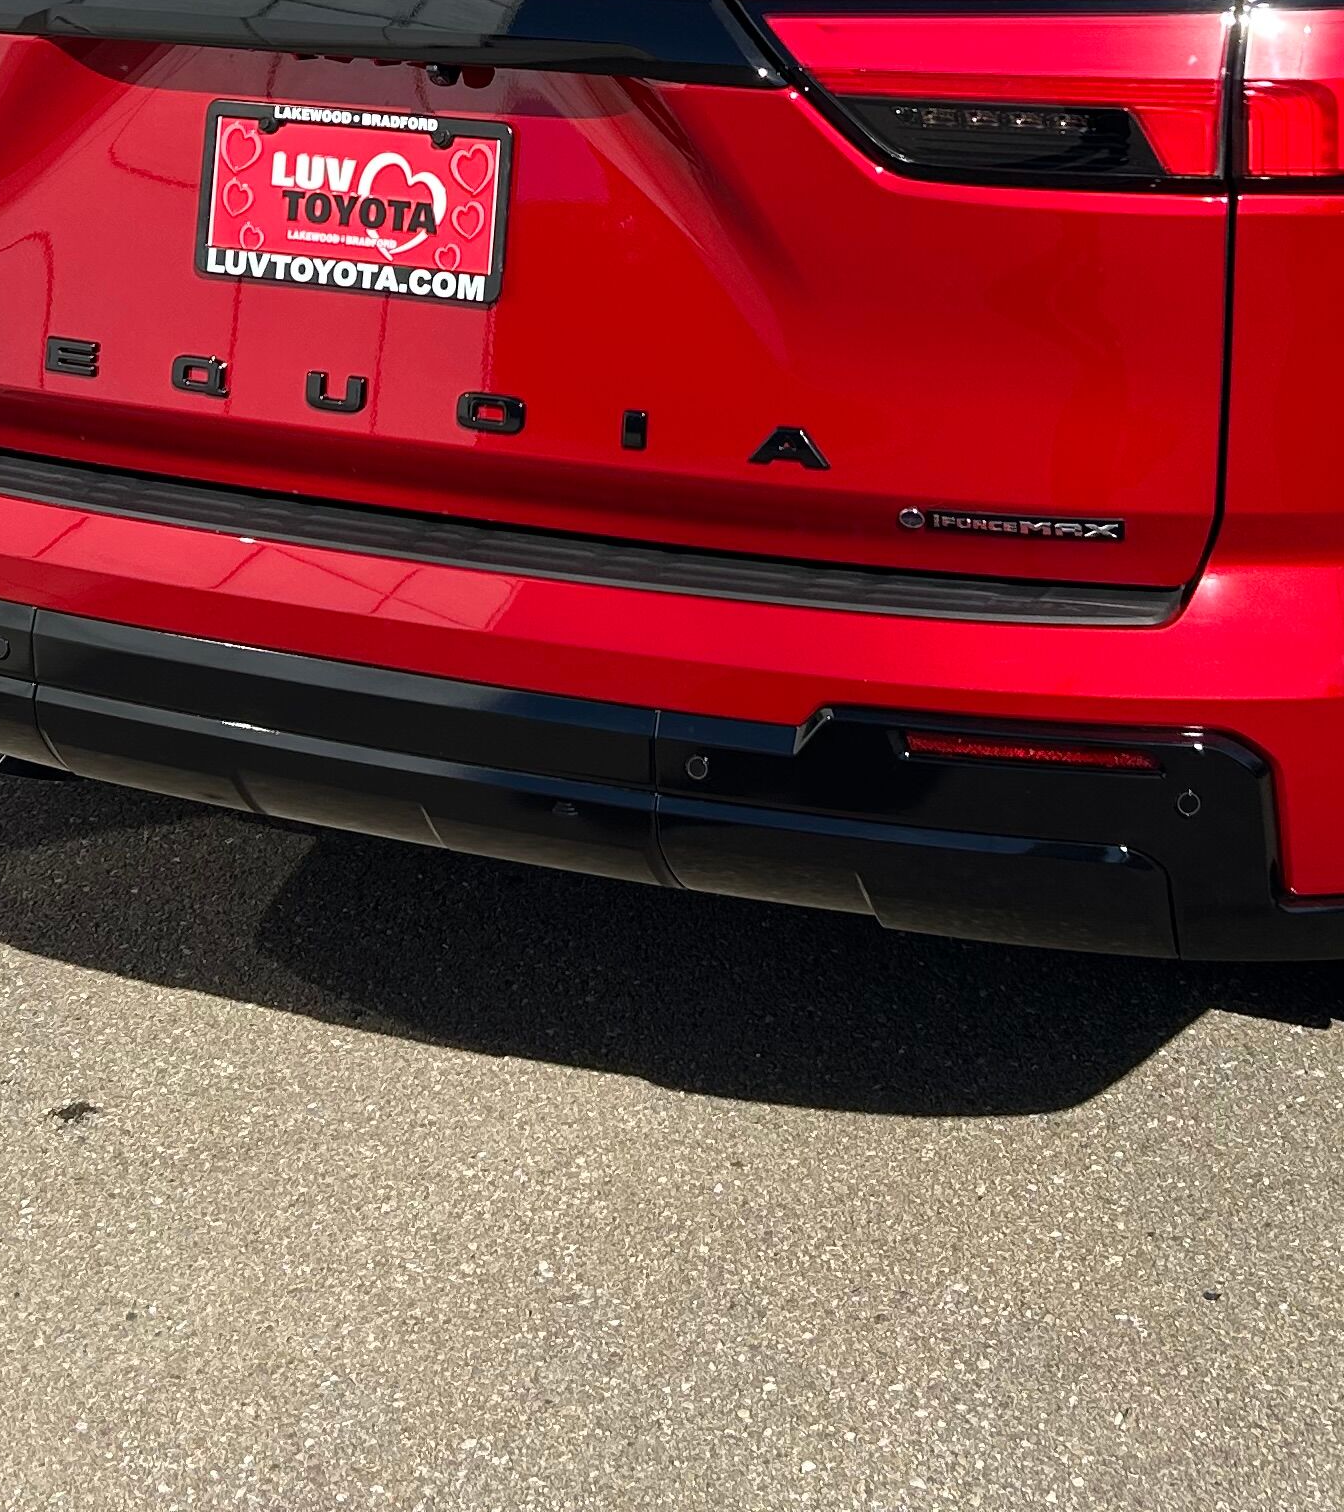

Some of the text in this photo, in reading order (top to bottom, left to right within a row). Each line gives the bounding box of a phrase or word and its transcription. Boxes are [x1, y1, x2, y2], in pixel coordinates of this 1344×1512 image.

[274, 105, 439, 132] LAKEWOOD BRADFORD
[271, 150, 357, 193] LUV
[282, 190, 438, 236] TOYOTA
[287, 229, 398, 250] LAKEWOOD BRADFORD
[206, 247, 486, 302] LUVTOYOTA.COM
